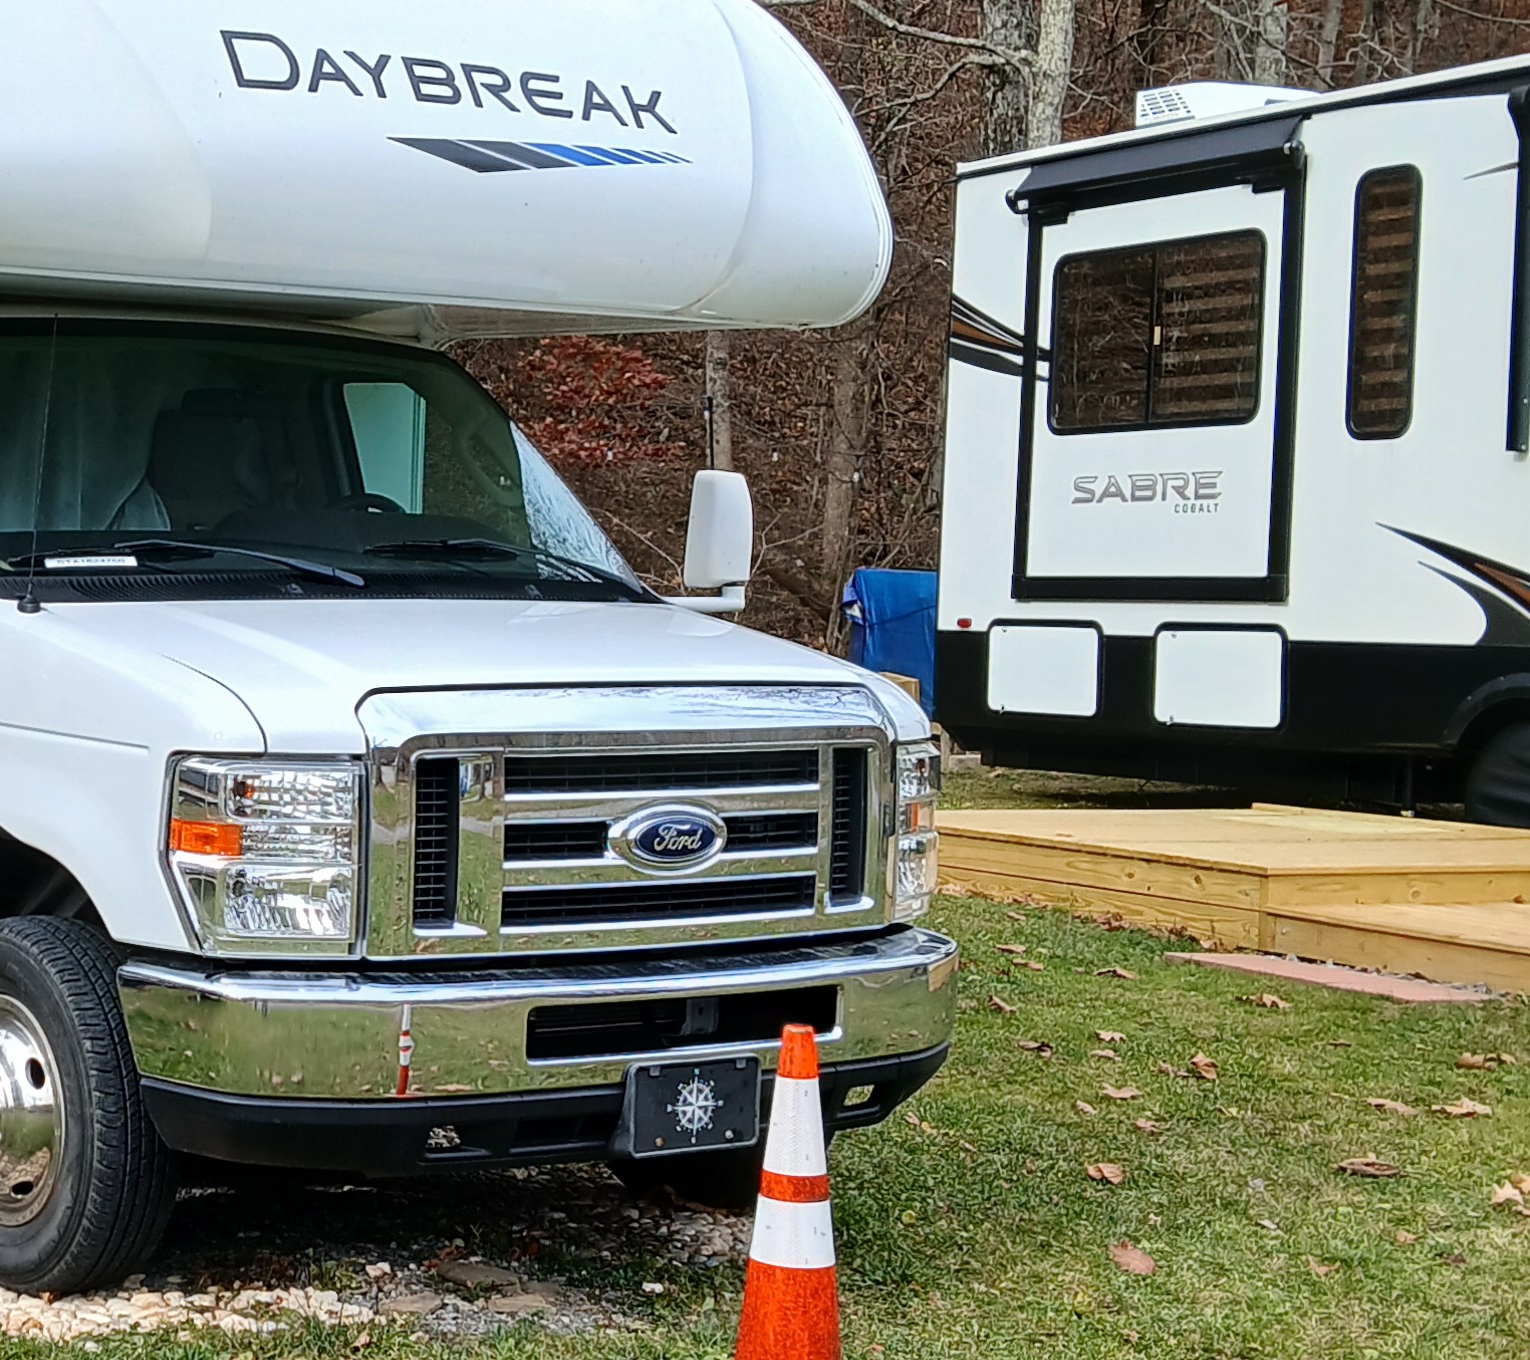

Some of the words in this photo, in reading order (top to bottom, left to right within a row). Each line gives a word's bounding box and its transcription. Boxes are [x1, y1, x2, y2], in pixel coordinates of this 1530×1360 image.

[220, 29, 678, 135] DAYBREAK
[1071, 470, 1223, 504] SABRE
[1174, 503, 1220, 514] COBALT
[653, 823, 703, 851] Ford
